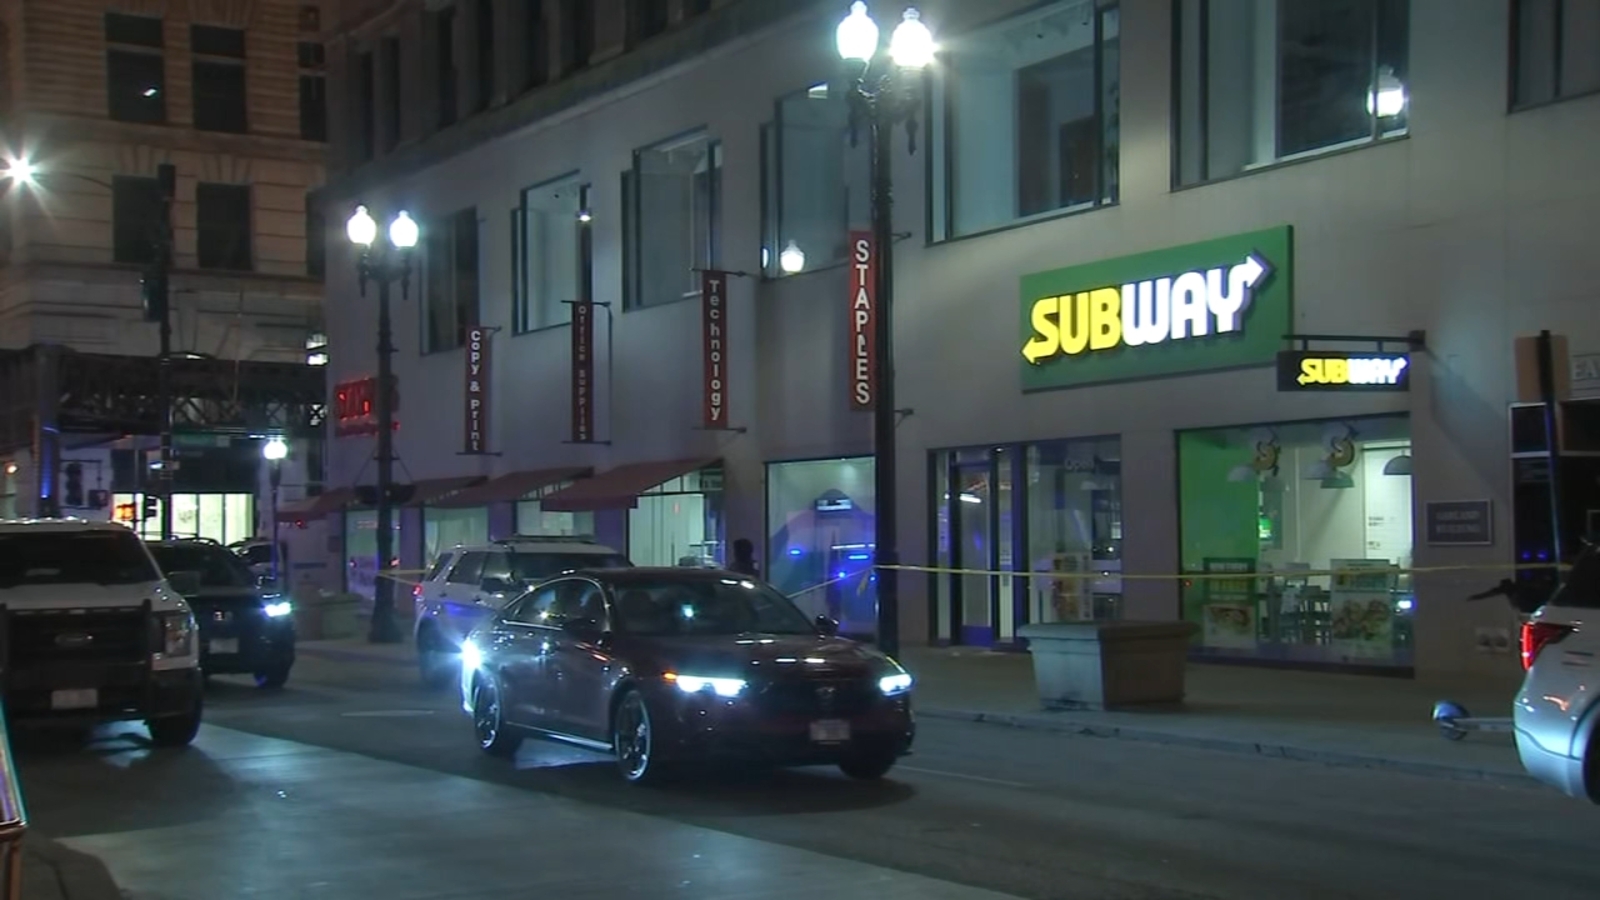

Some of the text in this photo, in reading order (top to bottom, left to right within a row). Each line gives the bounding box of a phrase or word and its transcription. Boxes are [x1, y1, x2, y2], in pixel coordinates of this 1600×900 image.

[708, 279, 721, 421] Technology
[854, 239, 871, 404] STAPLES
[1021, 255, 1265, 363] SUBWAY
[469, 330, 481, 451] Copy & Print
[1297, 357, 1407, 385] SUBWAY
